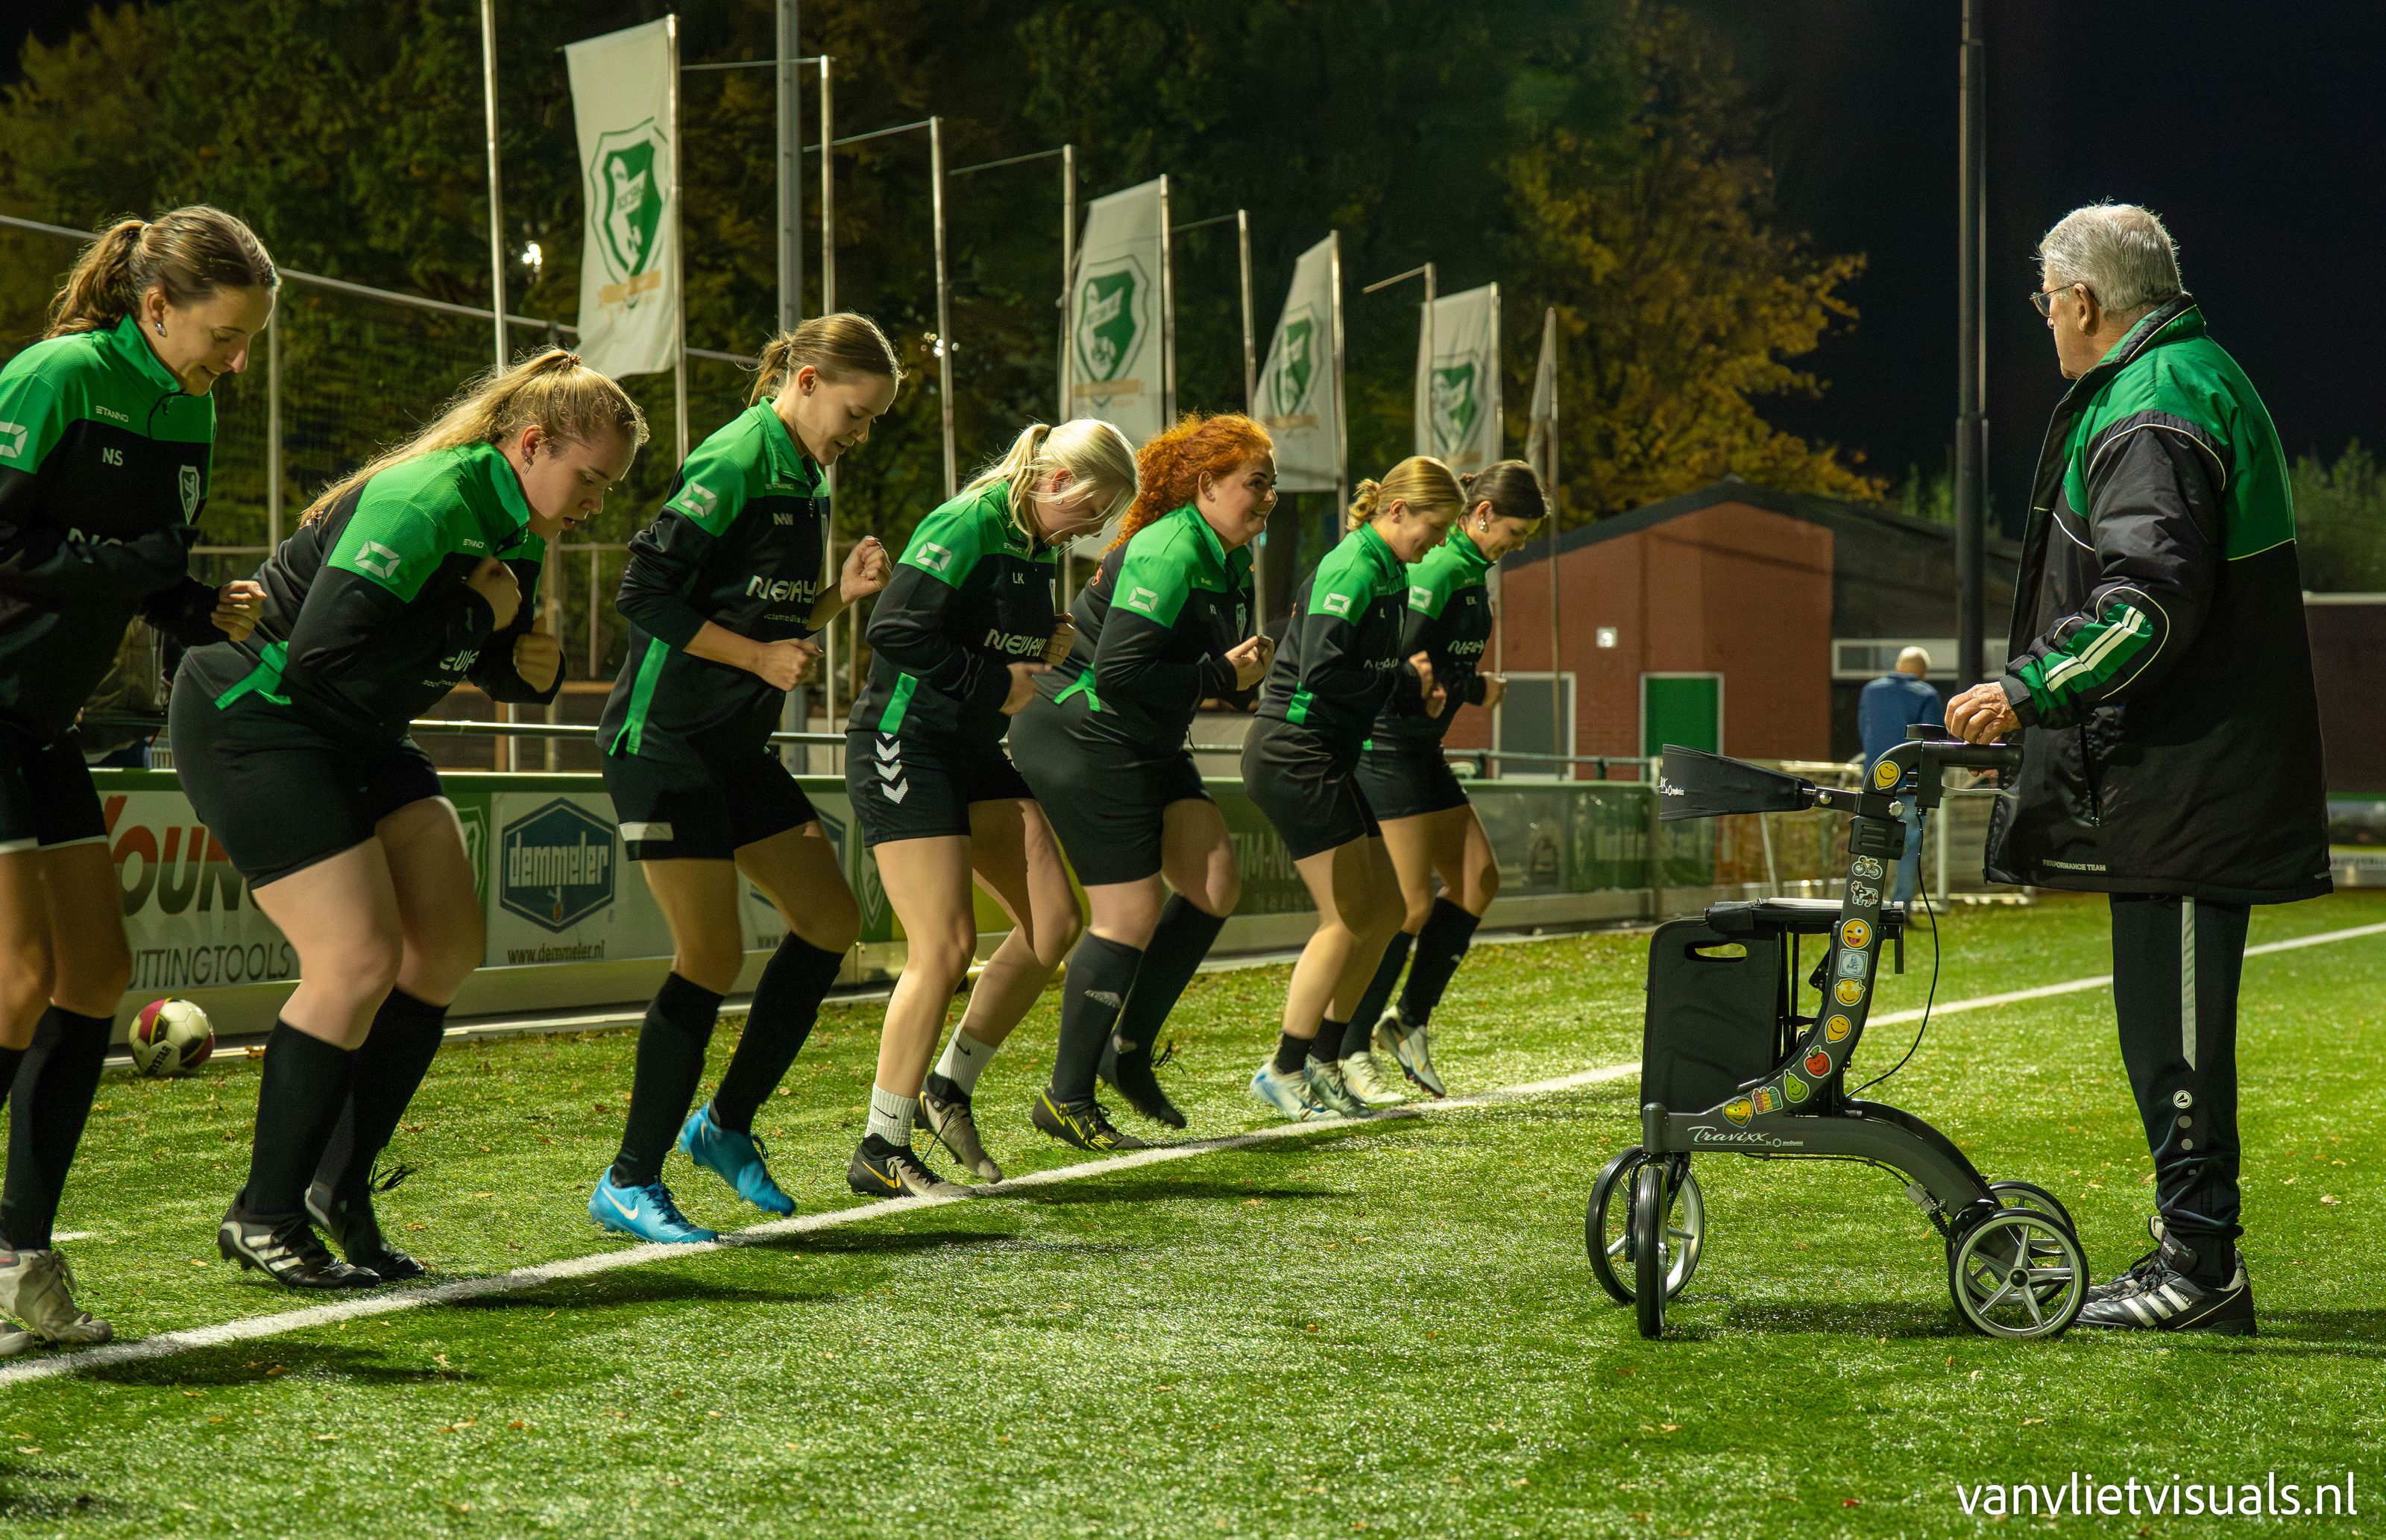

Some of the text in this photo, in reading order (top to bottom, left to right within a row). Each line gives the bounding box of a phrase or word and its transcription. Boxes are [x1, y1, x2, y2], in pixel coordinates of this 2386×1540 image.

[102, 447, 124, 466] NS
[1013, 572, 1025, 584] LK
[104, 795, 261, 918] OUN
[509, 830, 610, 887] demmeler
[507, 939, 605, 965] www.demmeler.nl
[1687, 1126, 1770, 1143] Travixx
